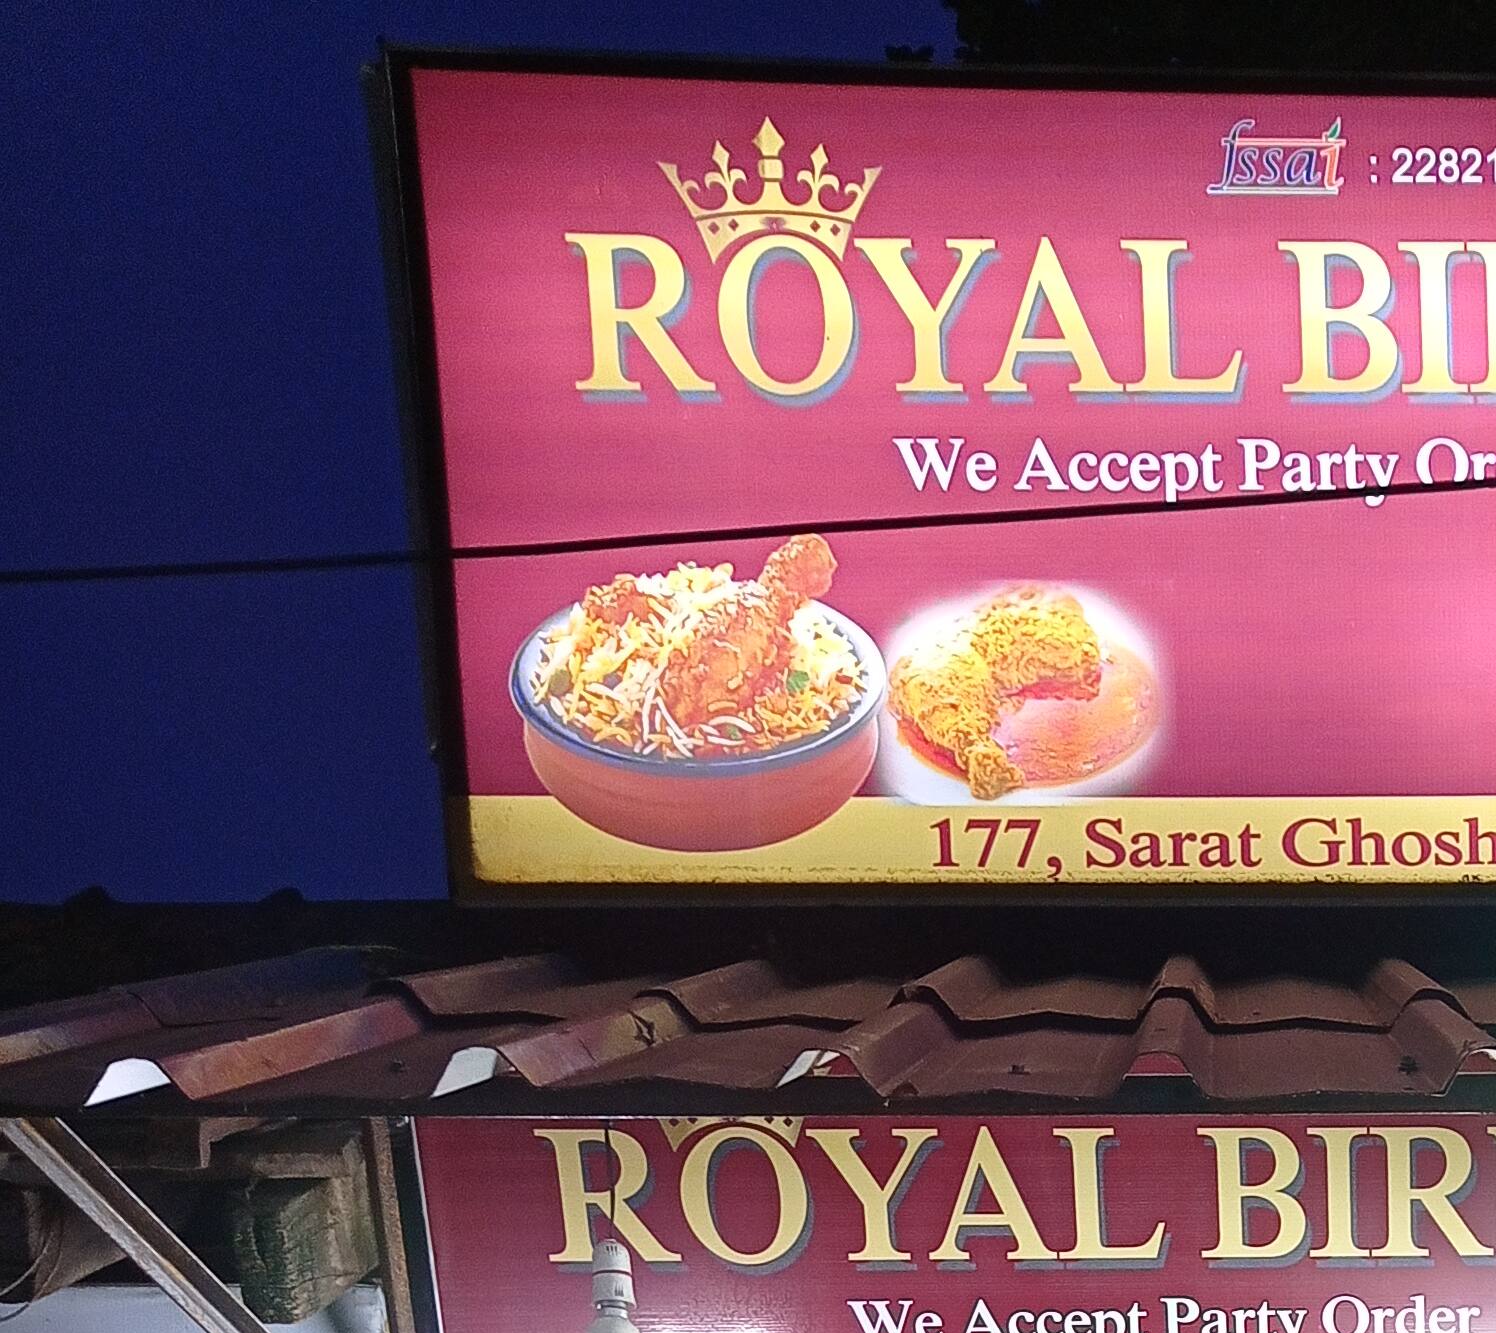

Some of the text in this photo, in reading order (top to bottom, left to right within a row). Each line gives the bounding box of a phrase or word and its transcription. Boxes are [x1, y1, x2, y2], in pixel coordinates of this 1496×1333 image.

[1207, 115, 1346, 197] fssai
[564, 232, 1247, 403] ROYAL
[894, 437, 996, 491] We
[1014, 438, 1223, 504] Accept
[1236, 437, 1399, 507] Party
[927, 816, 1065, 880] 177,
[1083, 816, 1260, 870] Sarat
[532, 1124, 1173, 1275] ROYAL
